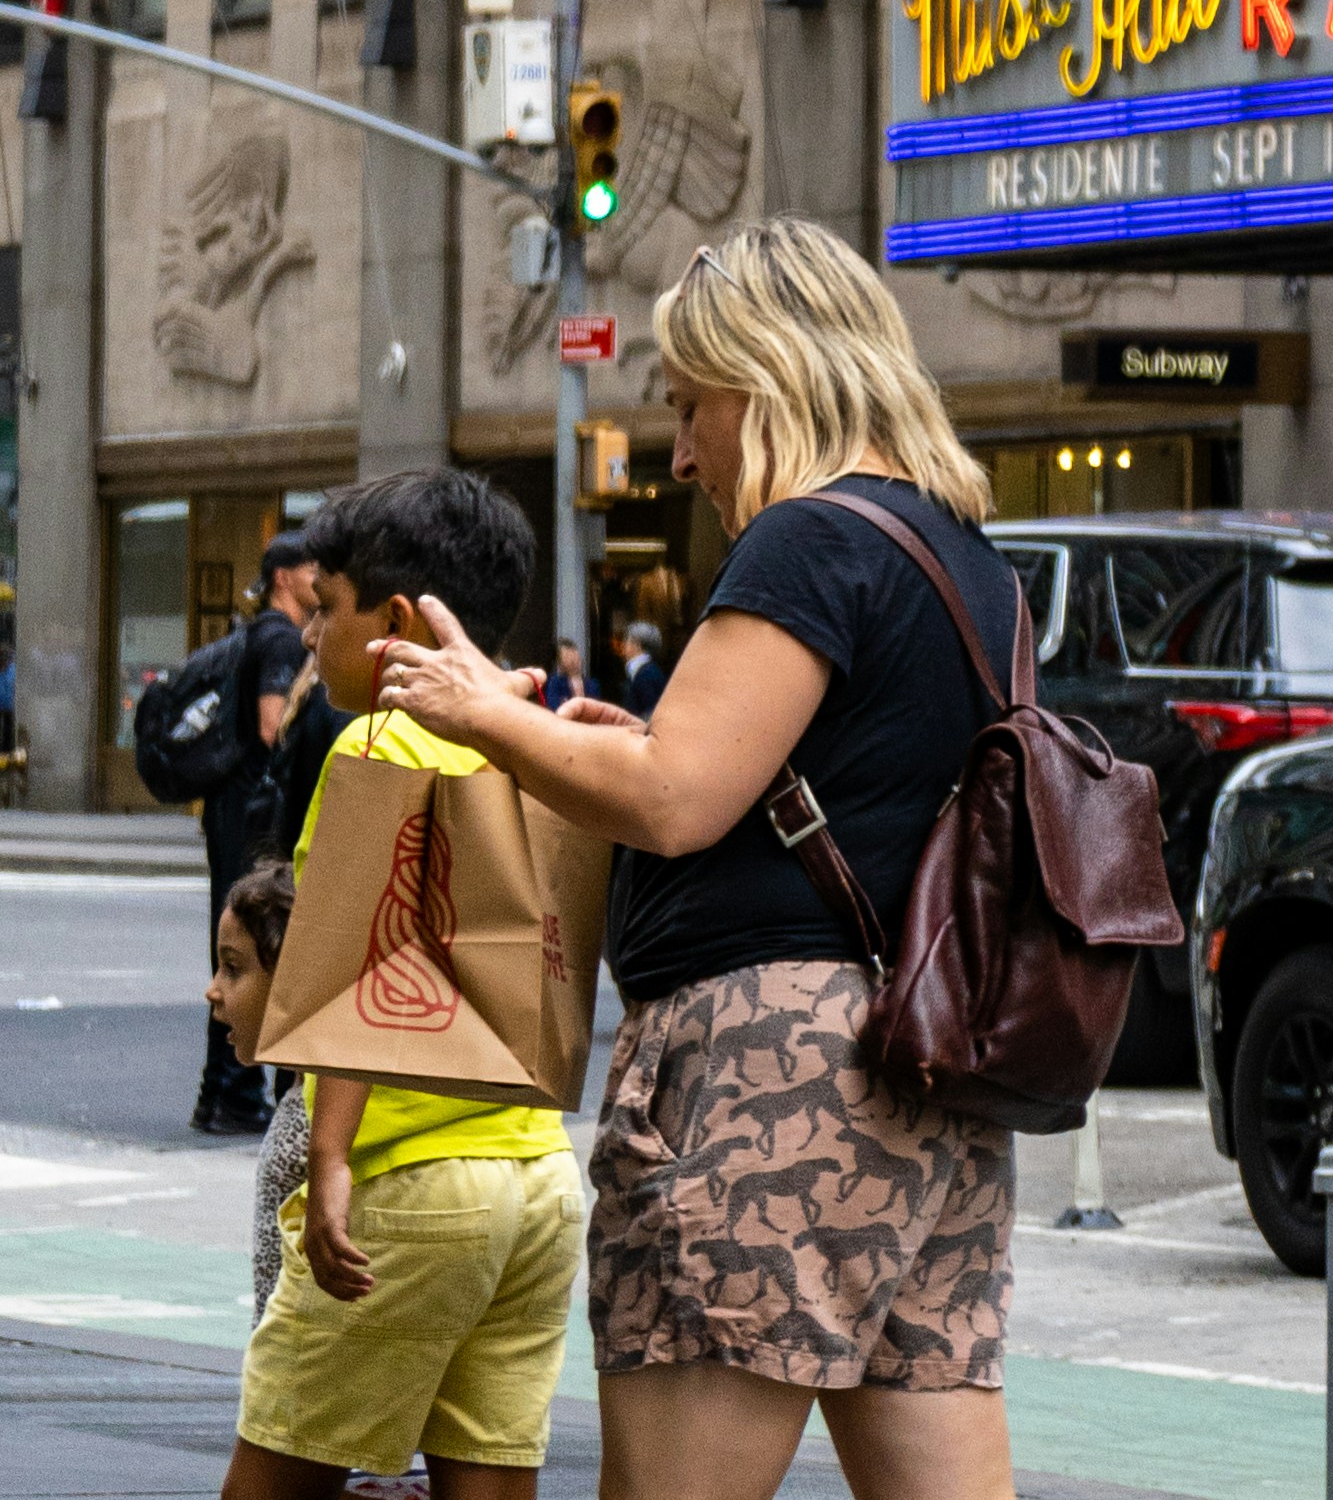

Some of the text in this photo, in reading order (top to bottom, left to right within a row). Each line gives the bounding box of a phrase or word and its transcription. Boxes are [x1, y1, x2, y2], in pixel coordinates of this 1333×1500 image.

[987, 136, 1165, 209] RESIDENTE
[1212, 122, 1298, 188] SEPT
[1121, 346, 1230, 386] Subway
